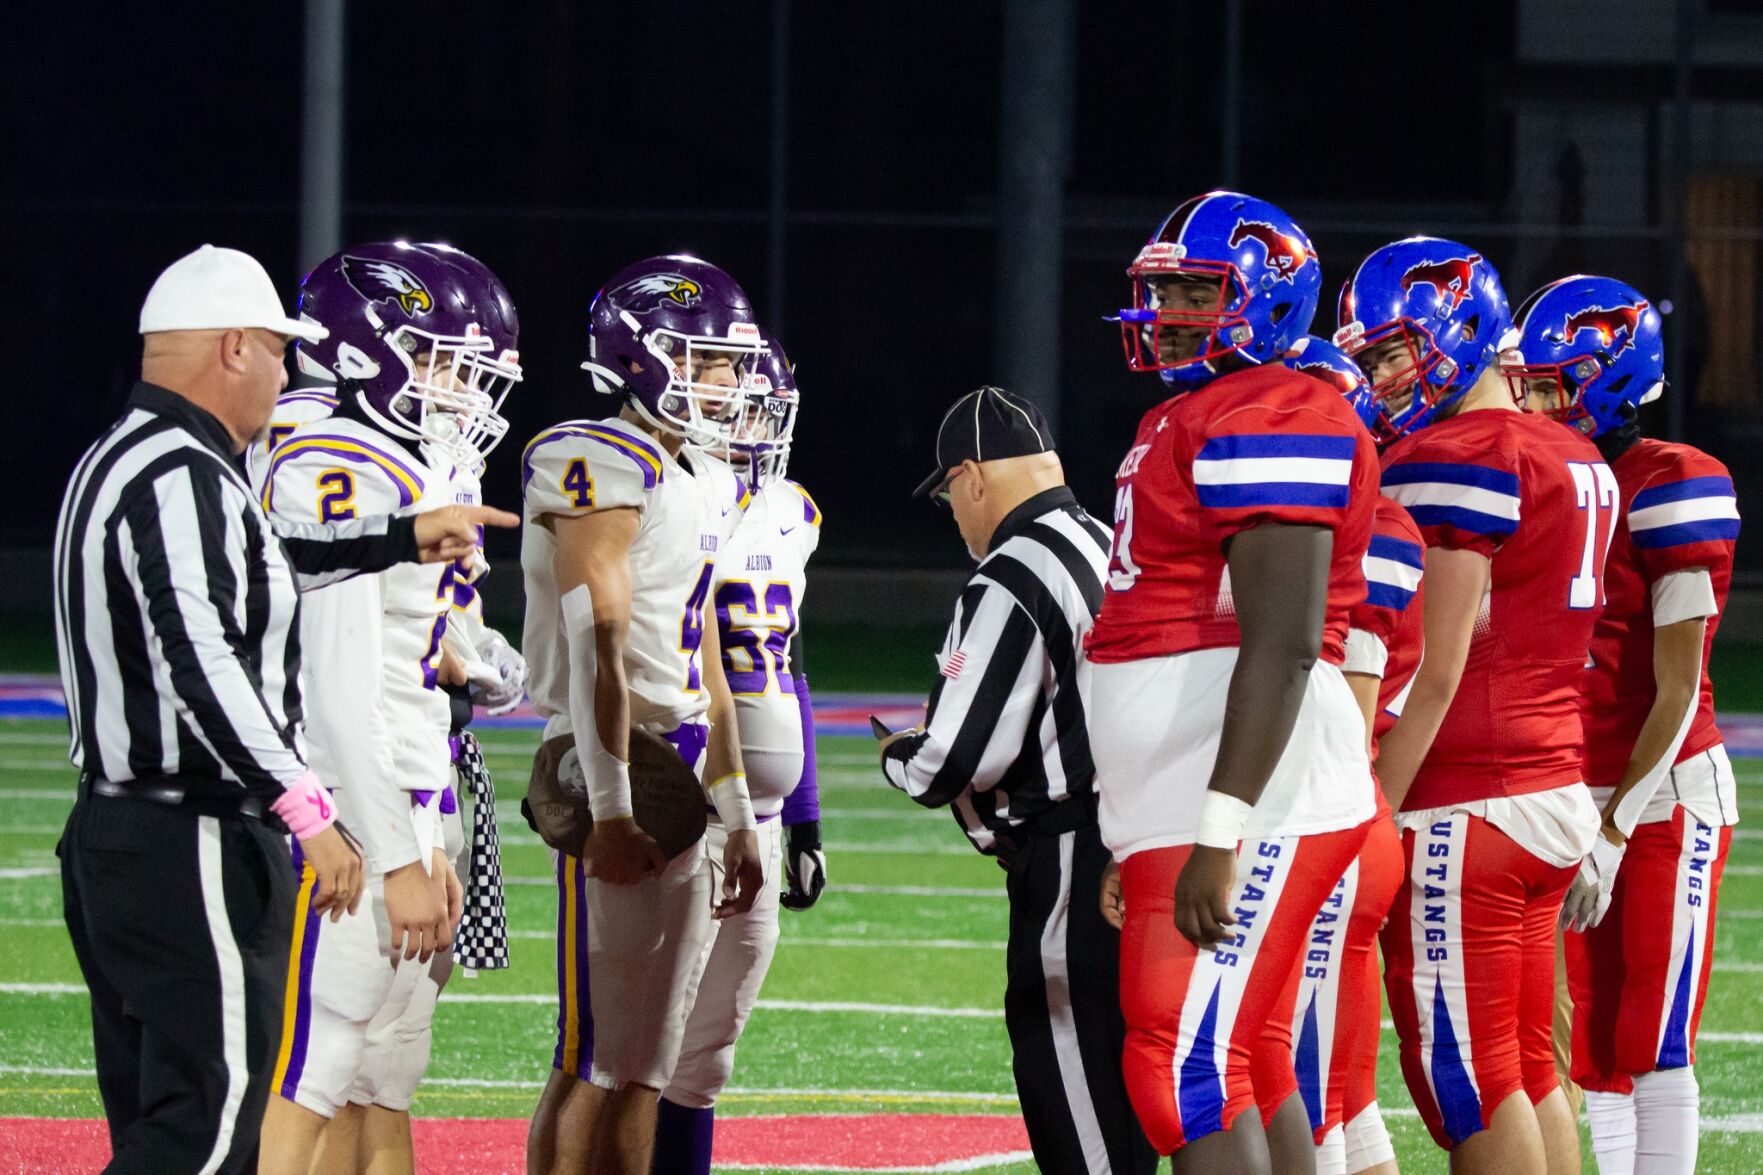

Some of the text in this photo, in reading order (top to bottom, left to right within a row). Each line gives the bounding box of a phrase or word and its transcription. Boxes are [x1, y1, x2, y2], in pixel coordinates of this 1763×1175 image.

[316, 467, 358, 524] 2
[561, 457, 595, 511] 4
[1566, 461, 1620, 610] 77
[1213, 837, 1283, 968] STANGS
